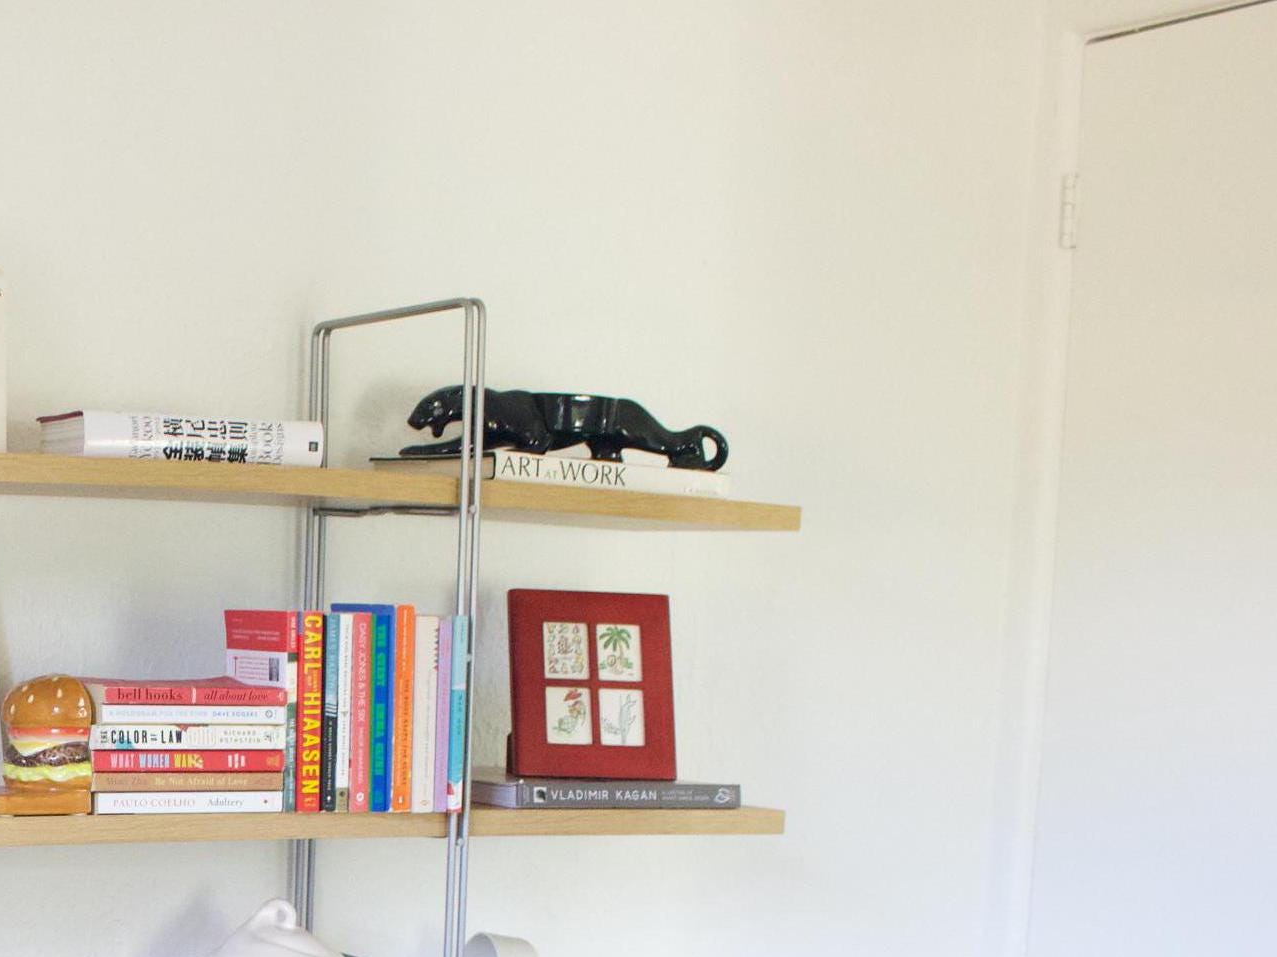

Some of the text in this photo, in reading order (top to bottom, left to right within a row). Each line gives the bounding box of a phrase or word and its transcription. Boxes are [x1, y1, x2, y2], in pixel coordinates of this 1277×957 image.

[501, 455, 544, 479] ART
[559, 460, 627, 487] WORK
[117, 687, 184, 700] bell hooks
[204, 689, 268, 701] all about love
[301, 615, 322, 794] CARL HIAASEN
[110, 729, 148, 745] COLOR
[161, 730, 183, 744] LAW
[110, 753, 204, 769] WHAT WOMEN WAN
[550, 789, 609, 801] VLADIMIR
[616, 789, 658, 802] KAGAN
[207, 798, 244, 808] Adultery
